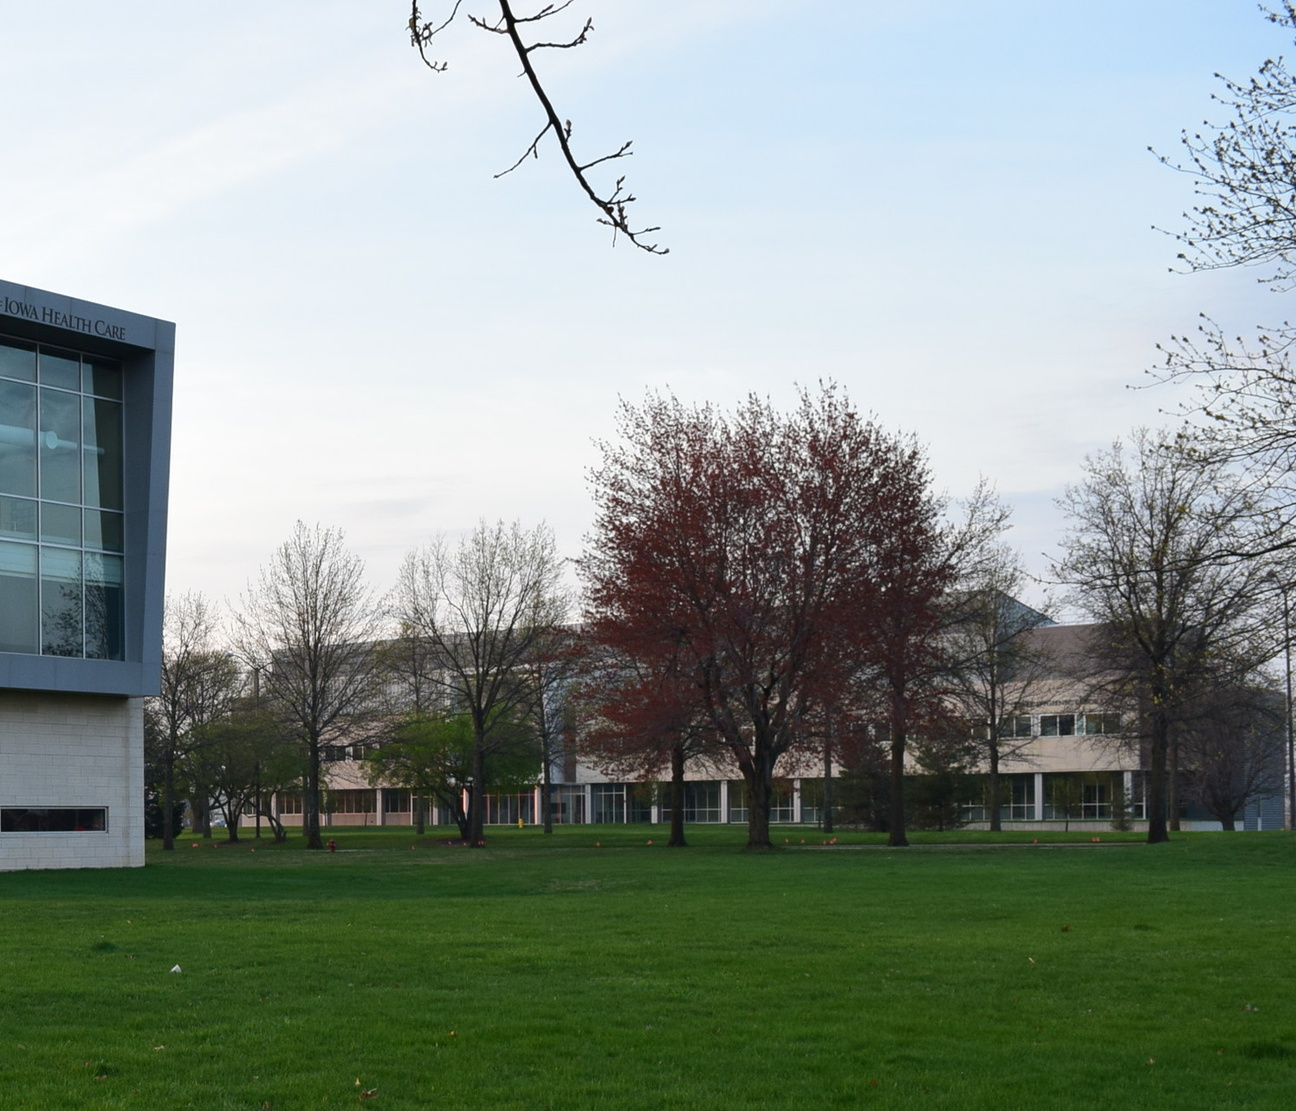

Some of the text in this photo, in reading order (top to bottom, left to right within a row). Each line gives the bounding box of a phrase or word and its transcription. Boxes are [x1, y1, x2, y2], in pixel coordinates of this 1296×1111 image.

[5, 296, 39, 321] IOWA
[42, 307, 92, 333] HEALTH
[94, 319, 126, 341] CARE
